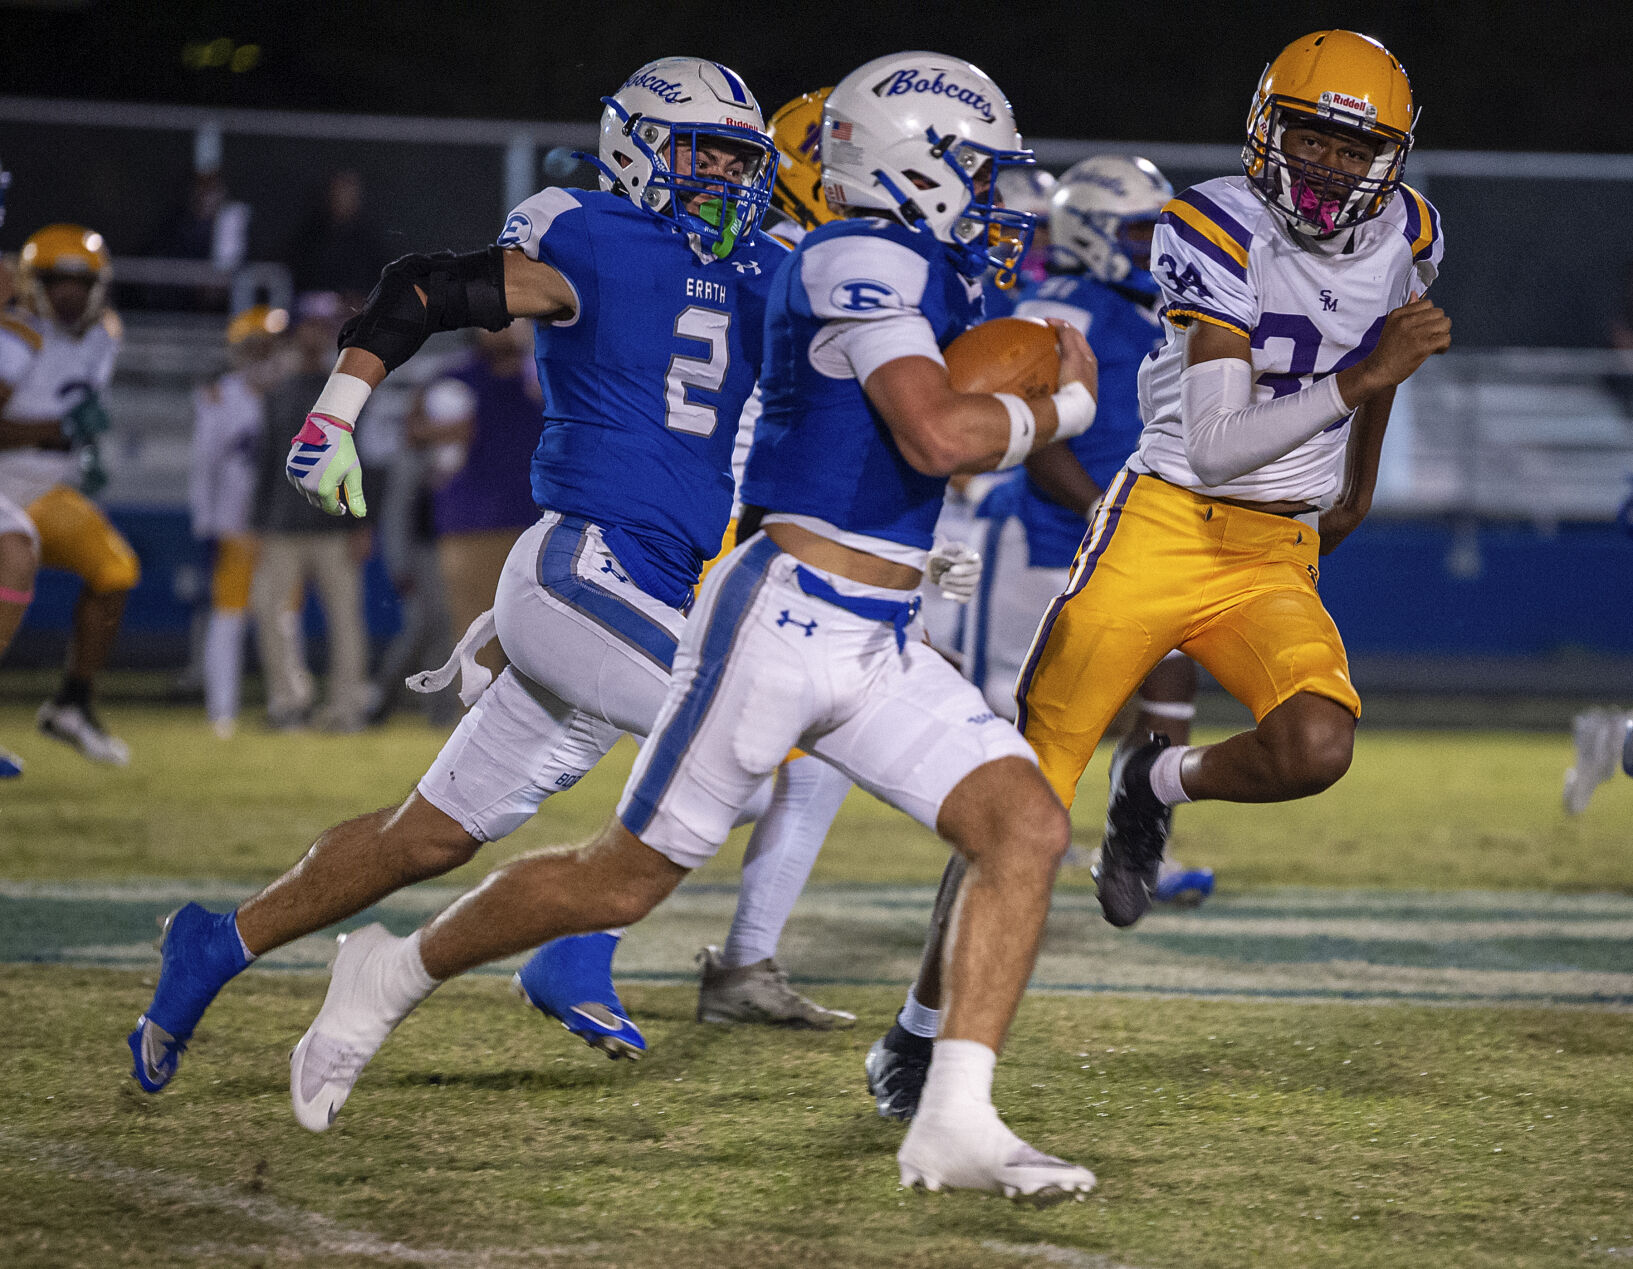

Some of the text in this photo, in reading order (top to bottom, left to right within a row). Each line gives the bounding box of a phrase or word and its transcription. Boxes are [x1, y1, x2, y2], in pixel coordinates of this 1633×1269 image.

[886, 69, 992, 118] Bobcats
[1333, 94, 1366, 111] Riddell
[686, 277, 727, 303] ERATH
[1158, 253, 1214, 299] 34
[841, 282, 893, 311] E
[1319, 289, 1339, 312] SM
[664, 305, 731, 438] 2
